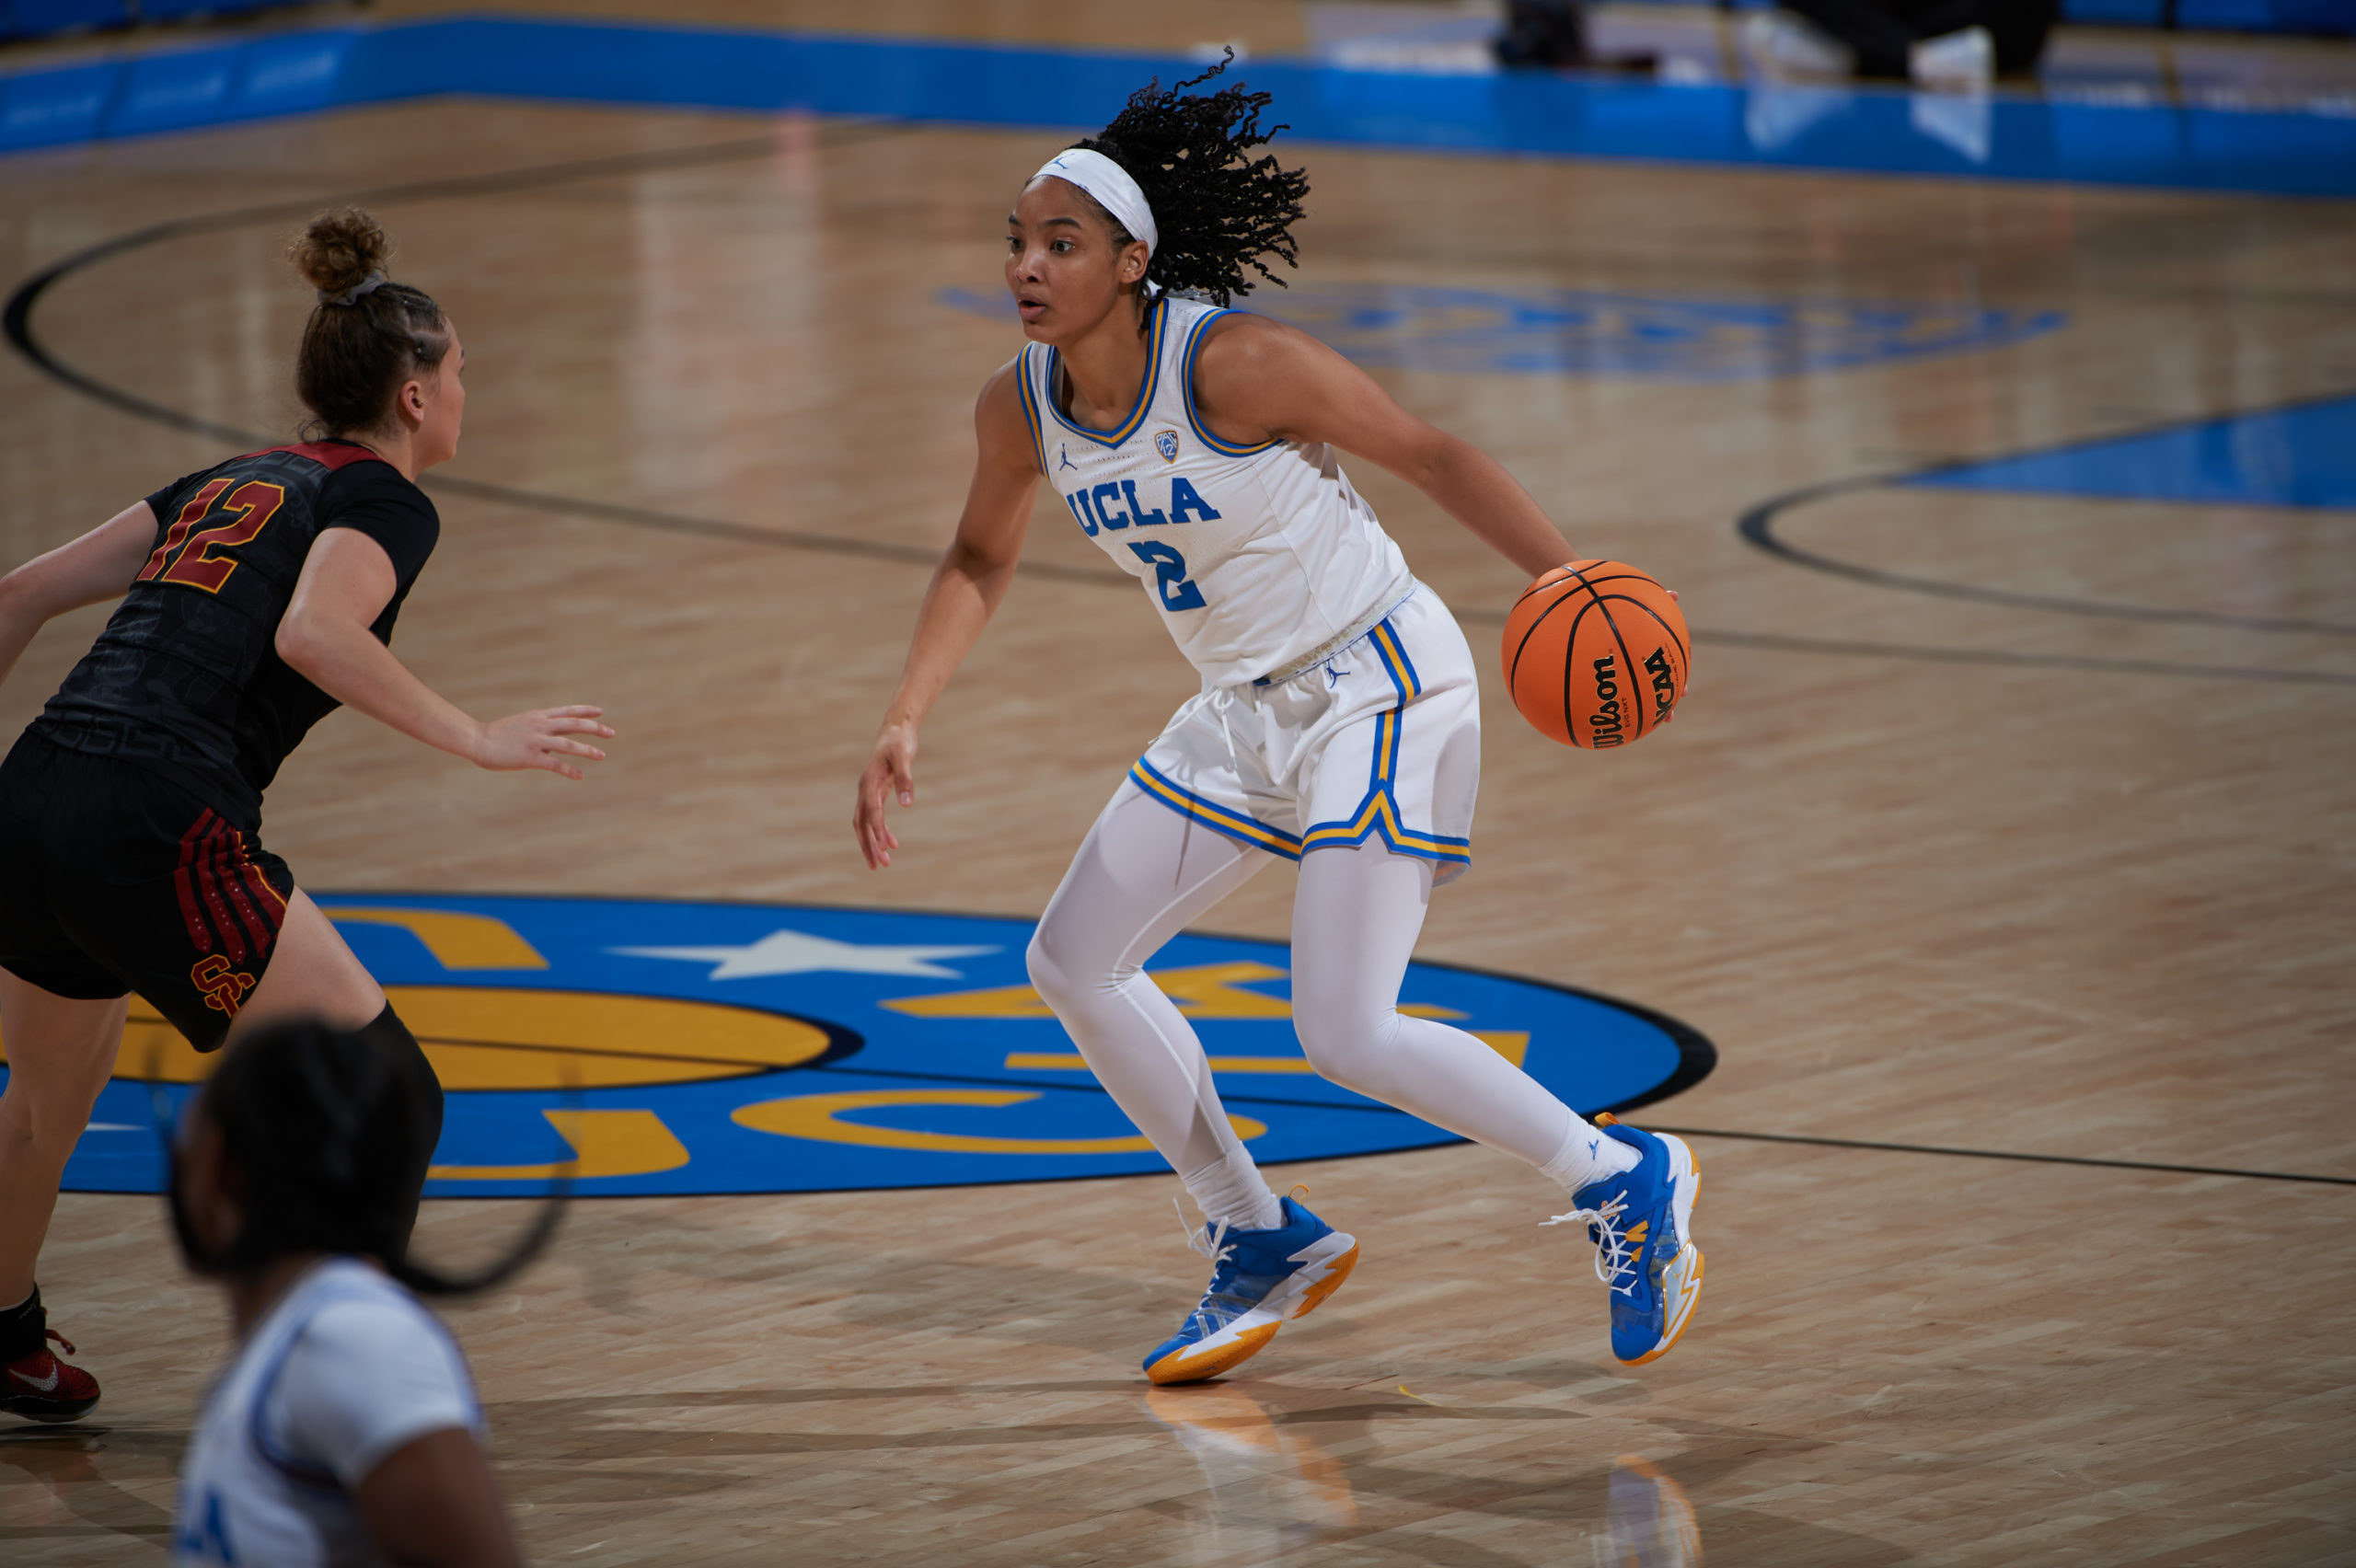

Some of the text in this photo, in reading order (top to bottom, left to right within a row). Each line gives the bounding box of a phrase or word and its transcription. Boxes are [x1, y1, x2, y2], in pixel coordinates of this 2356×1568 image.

[1162, 444, 1175, 457] 12
[137, 478, 285, 594] 12
[1066, 477, 1222, 537] UCLA
[1126, 540, 1207, 612] 2
[1589, 654, 1624, 750] Wilson
[1623, 713, 1631, 728] EVO
[1643, 646, 1675, 727] NCAA
